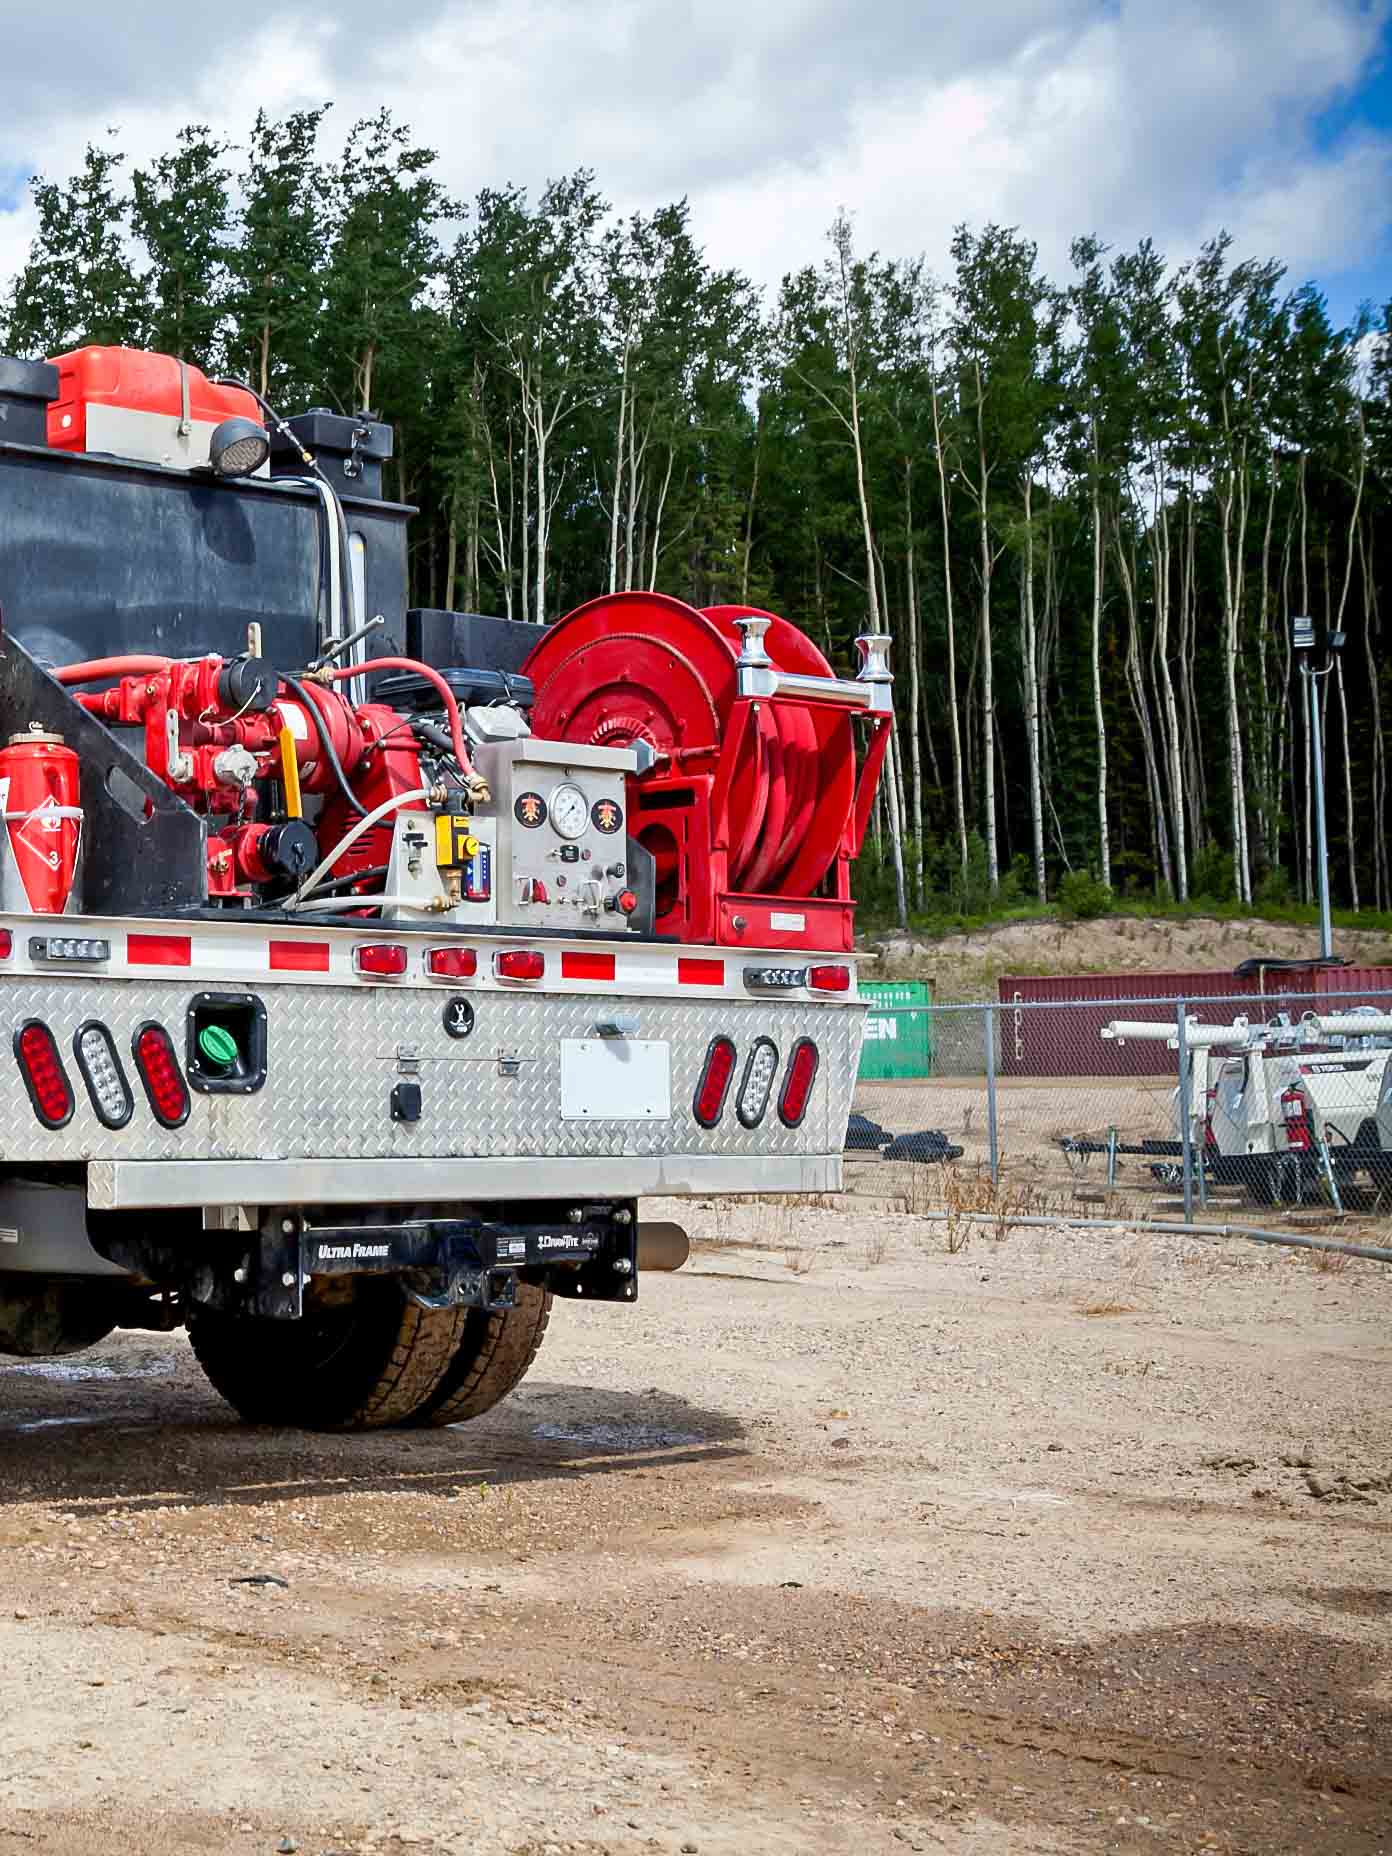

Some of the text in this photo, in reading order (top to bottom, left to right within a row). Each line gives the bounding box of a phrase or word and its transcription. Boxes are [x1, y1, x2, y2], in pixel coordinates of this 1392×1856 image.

[49, 851, 59, 864] 3
[318, 1243, 389, 1259] ULTRA FRAME
